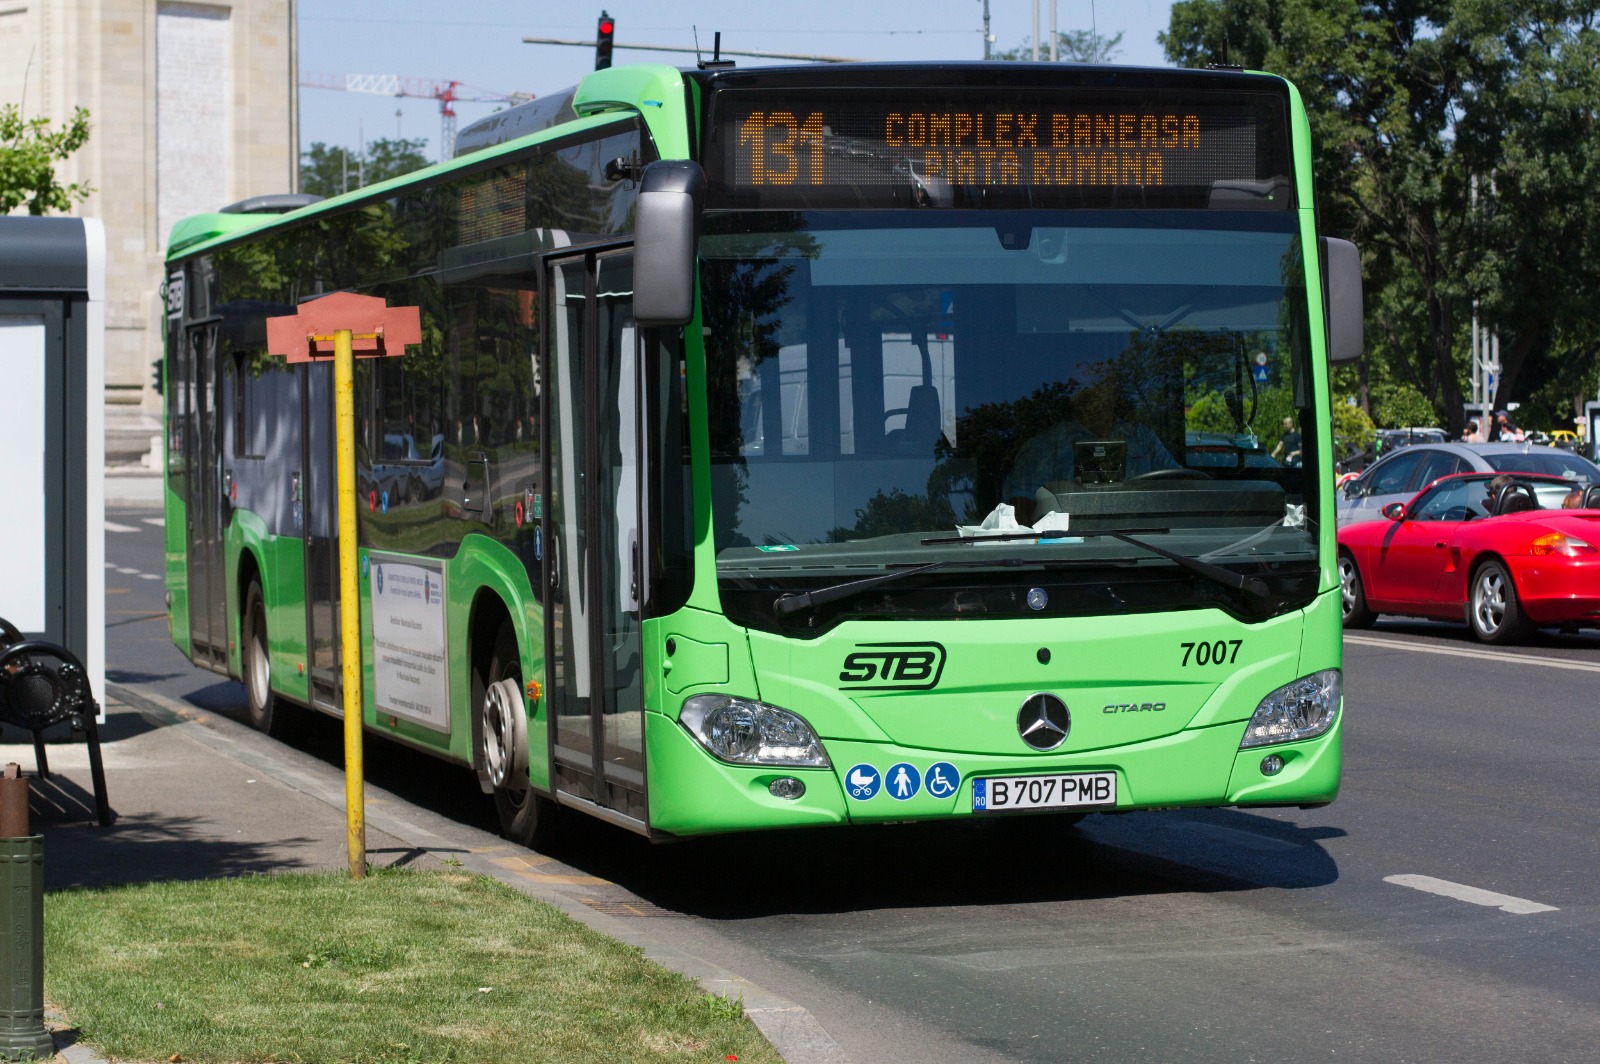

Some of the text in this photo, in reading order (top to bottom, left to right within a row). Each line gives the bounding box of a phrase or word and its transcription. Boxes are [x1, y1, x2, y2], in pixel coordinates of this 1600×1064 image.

[886, 112, 1200, 149] COMPLEX BANEASA
[740, 111, 823, 185] 131
[925, 151, 1164, 185] PIATA ROMANA
[838, 650, 936, 682] STB
[1180, 639, 1243, 667] 7007
[1102, 702, 1167, 714] CITARO
[975, 796, 986, 806] RO
[992, 776, 1111, 806] B 707 PMB
